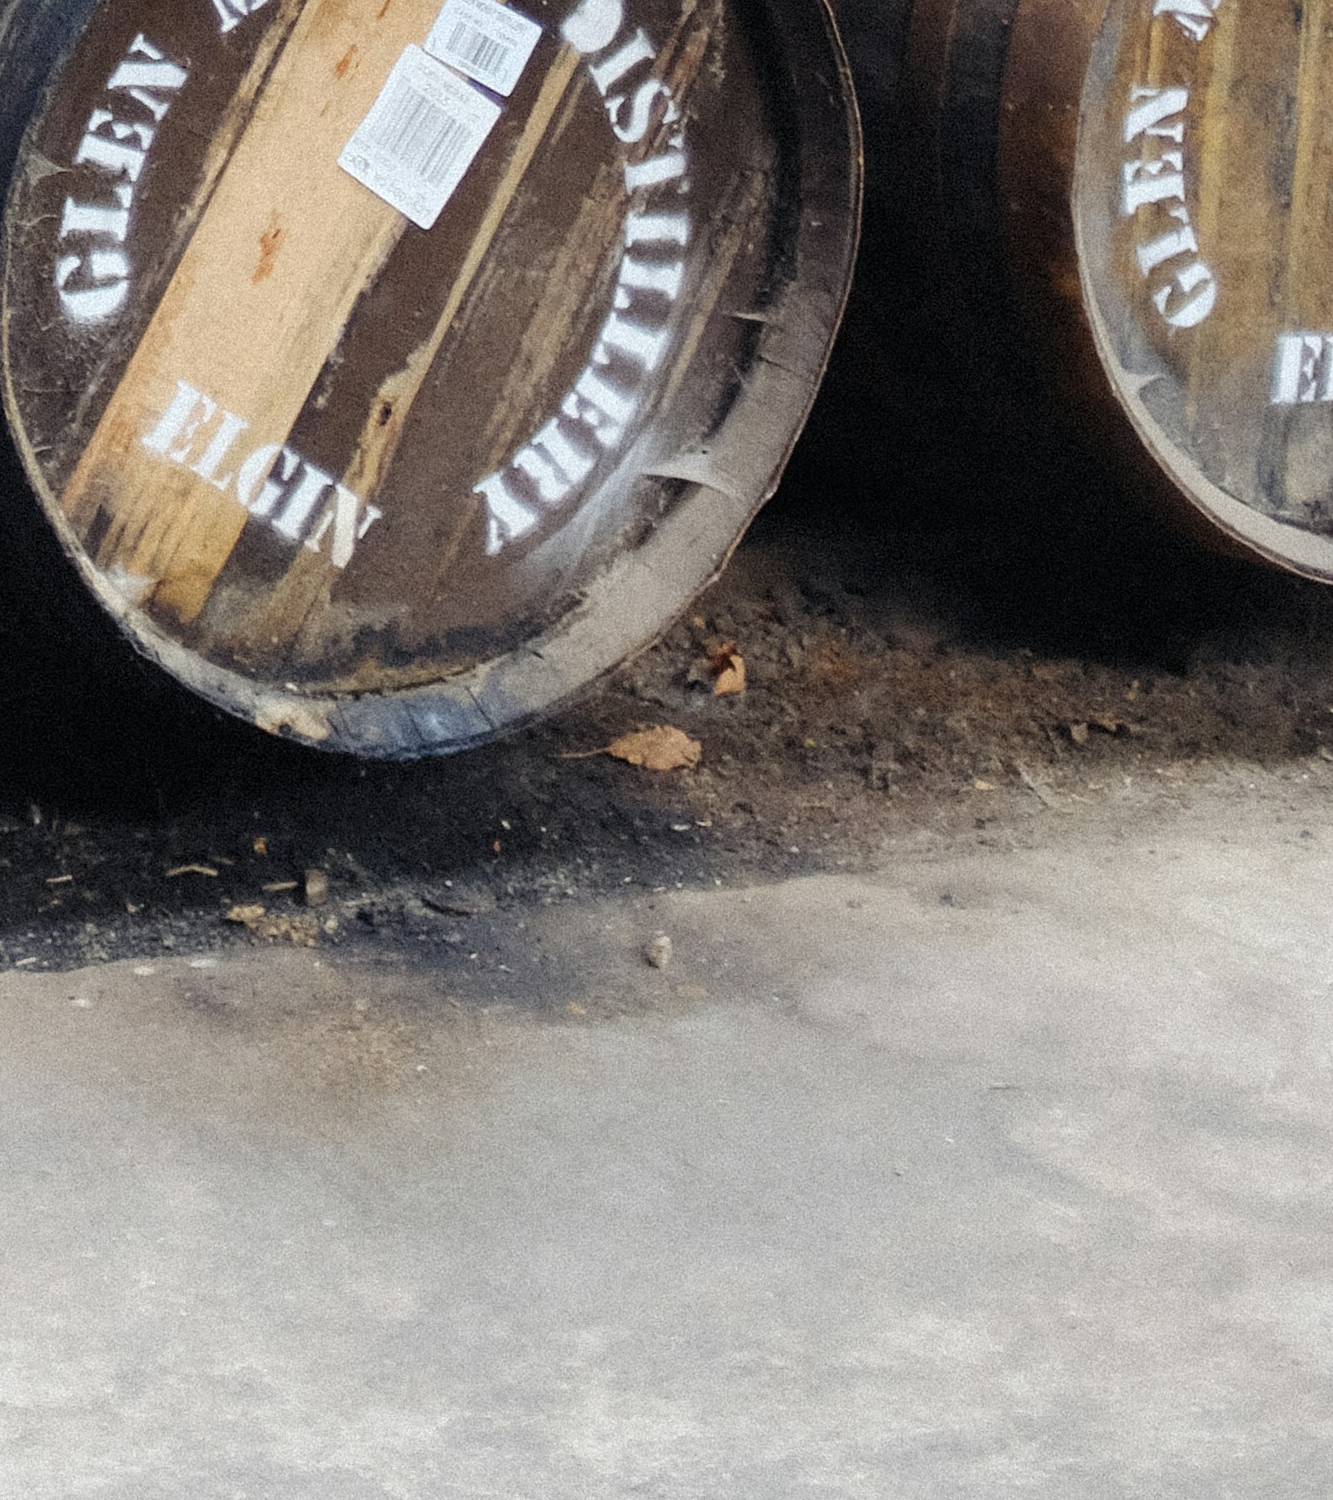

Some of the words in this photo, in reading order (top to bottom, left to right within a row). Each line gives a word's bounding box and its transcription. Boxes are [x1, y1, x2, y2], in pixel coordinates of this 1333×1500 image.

[55, 34, 190, 328] GLEN
[1121, 84, 1217, 330] GLEN
[140, 380, 384, 571] ELGIN
